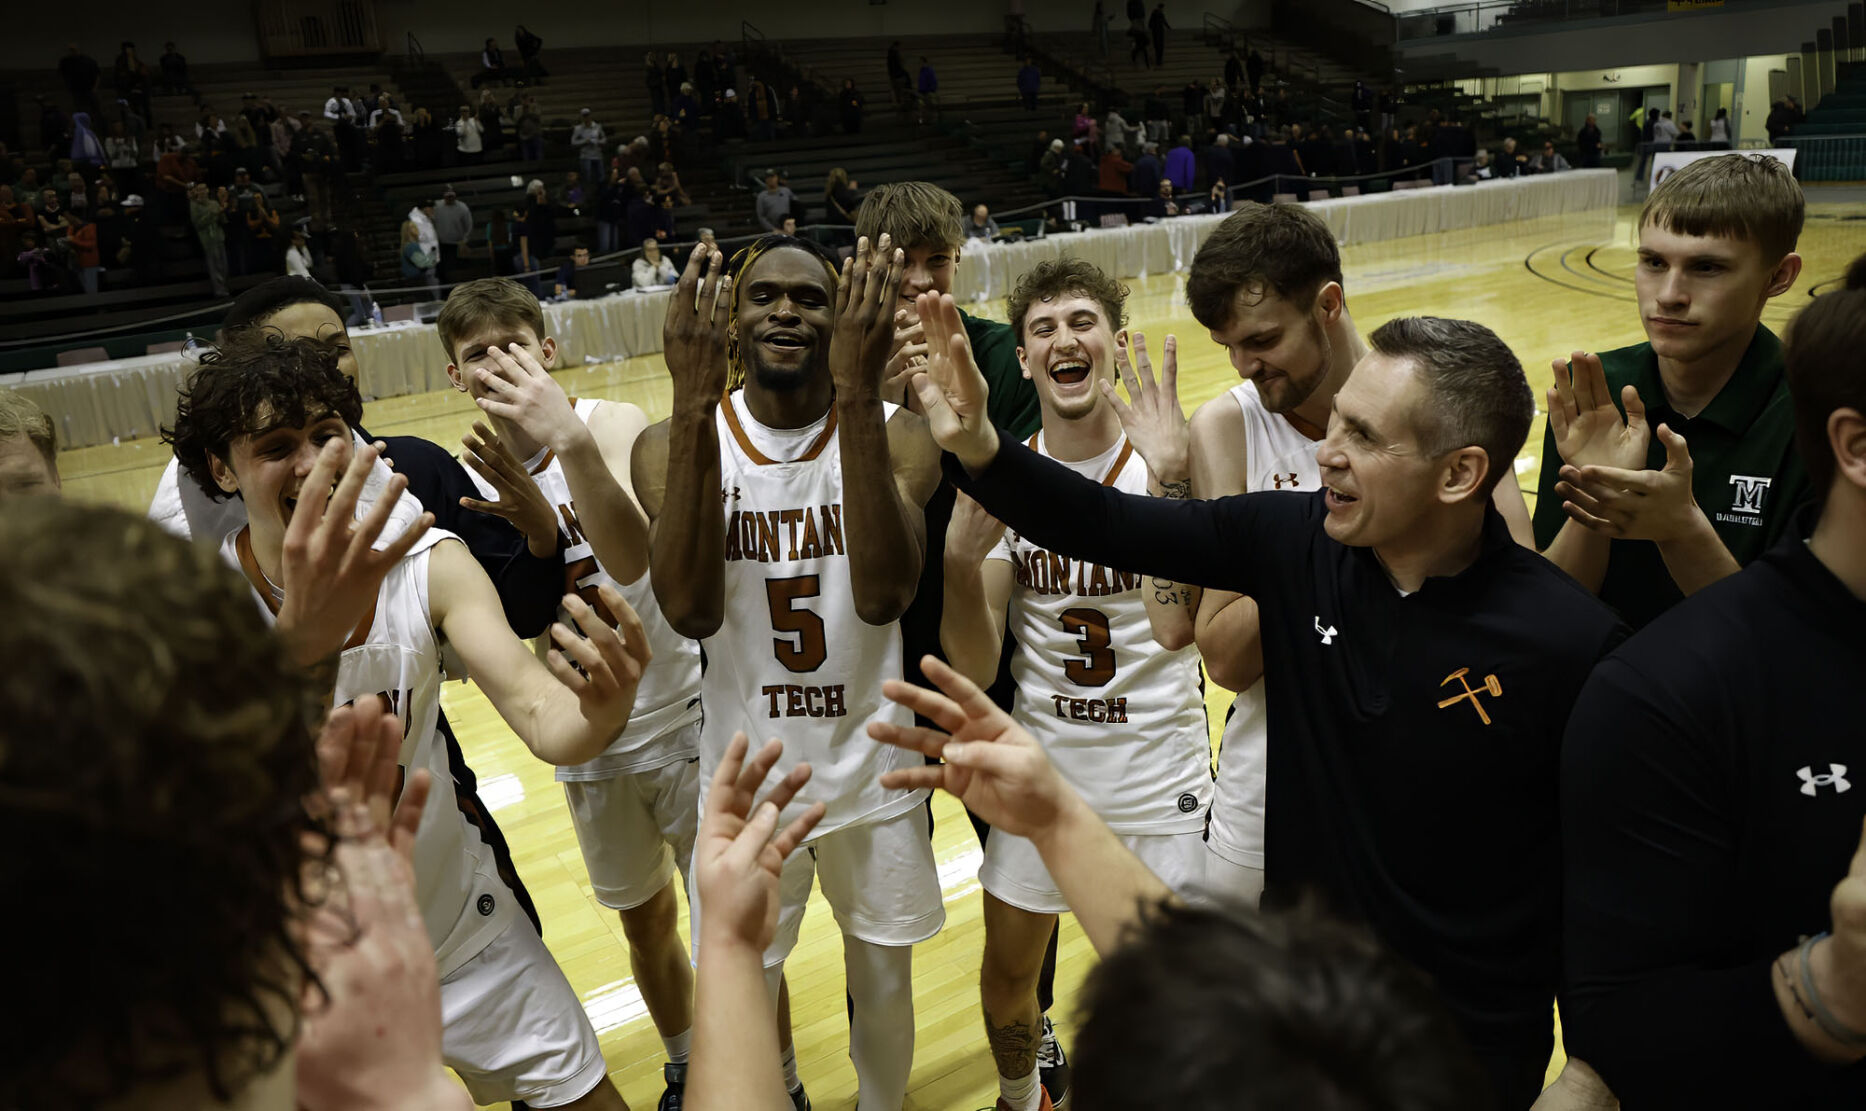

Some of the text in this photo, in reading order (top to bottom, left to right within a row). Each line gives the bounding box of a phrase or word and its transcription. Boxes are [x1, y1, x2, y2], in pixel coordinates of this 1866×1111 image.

[765, 574, 827, 673] 5
[1058, 607, 1117, 687] 3
[762, 684, 847, 718] TECH
[1051, 694, 1128, 723] TECH
